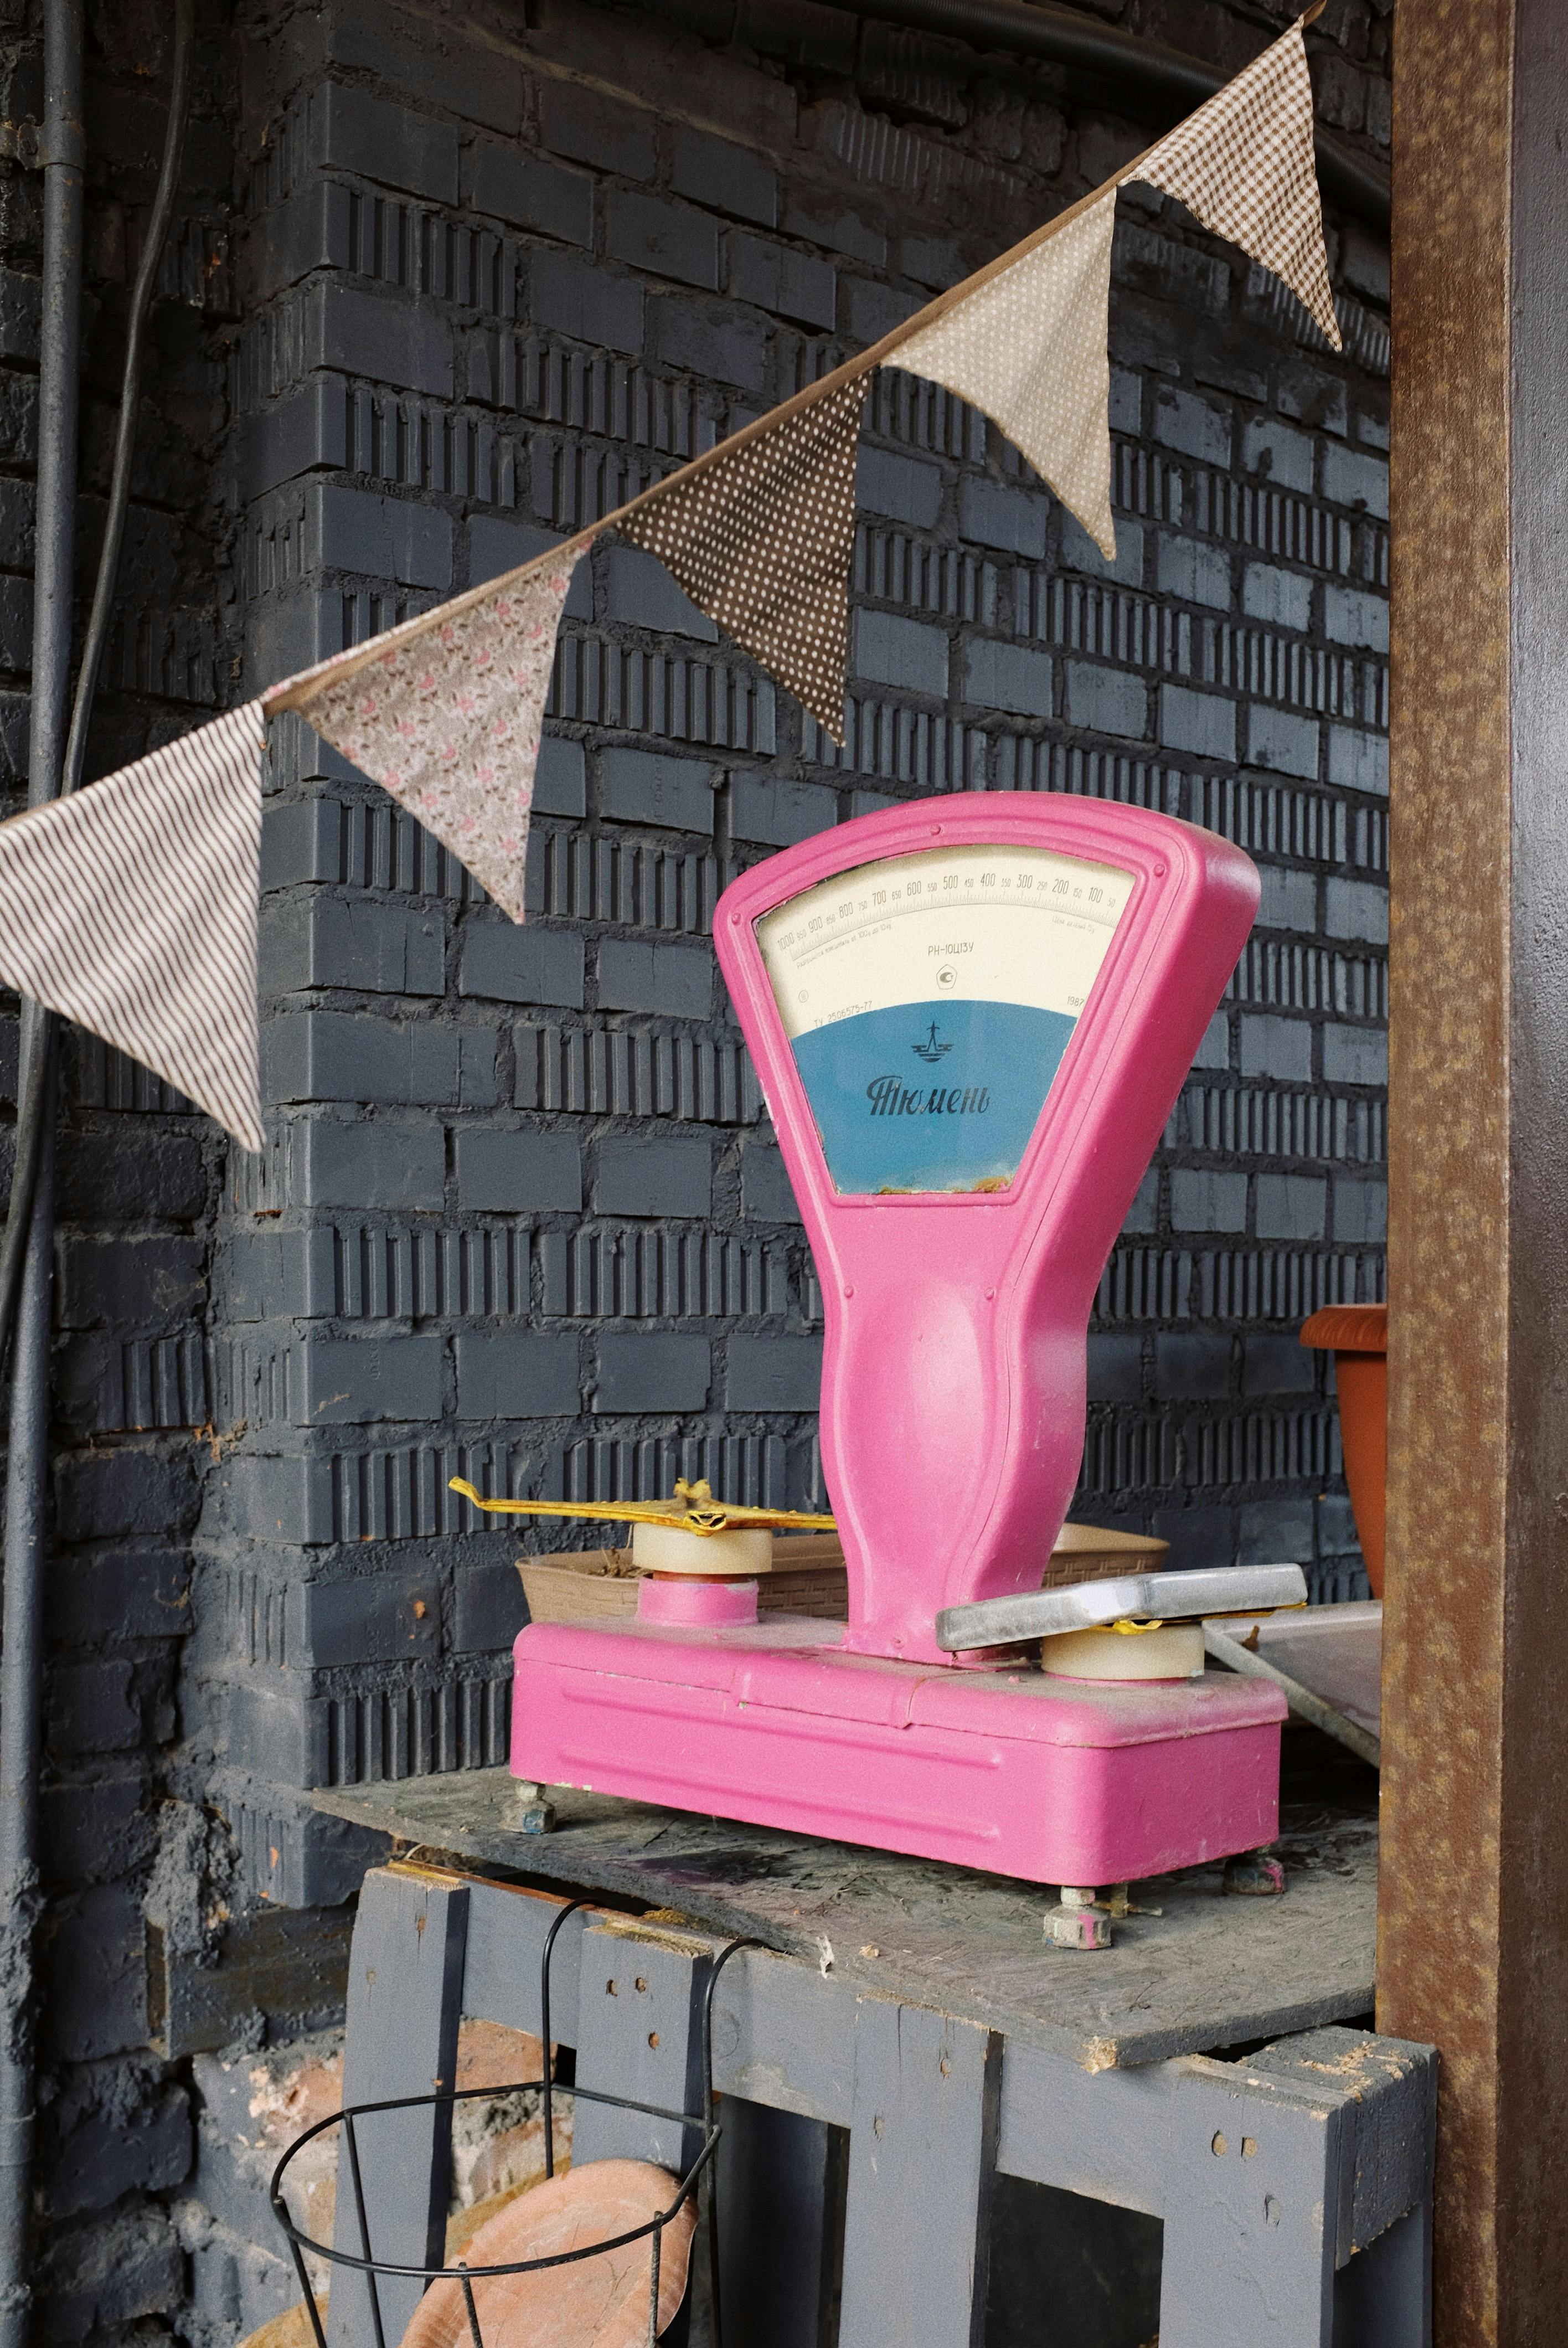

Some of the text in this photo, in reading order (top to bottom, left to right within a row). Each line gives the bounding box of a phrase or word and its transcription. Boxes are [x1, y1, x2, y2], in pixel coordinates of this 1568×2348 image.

[778, 873, 1116, 951] 1000 950 900 850 800 750 700 650 600 550 500 450 400 350 300 250 200 150 100 50
[928, 942, 973, 956] РН-10Ц13У
[1067, 996, 1085, 1007] 1987
[866, 1075, 991, 1116] Тюмень
